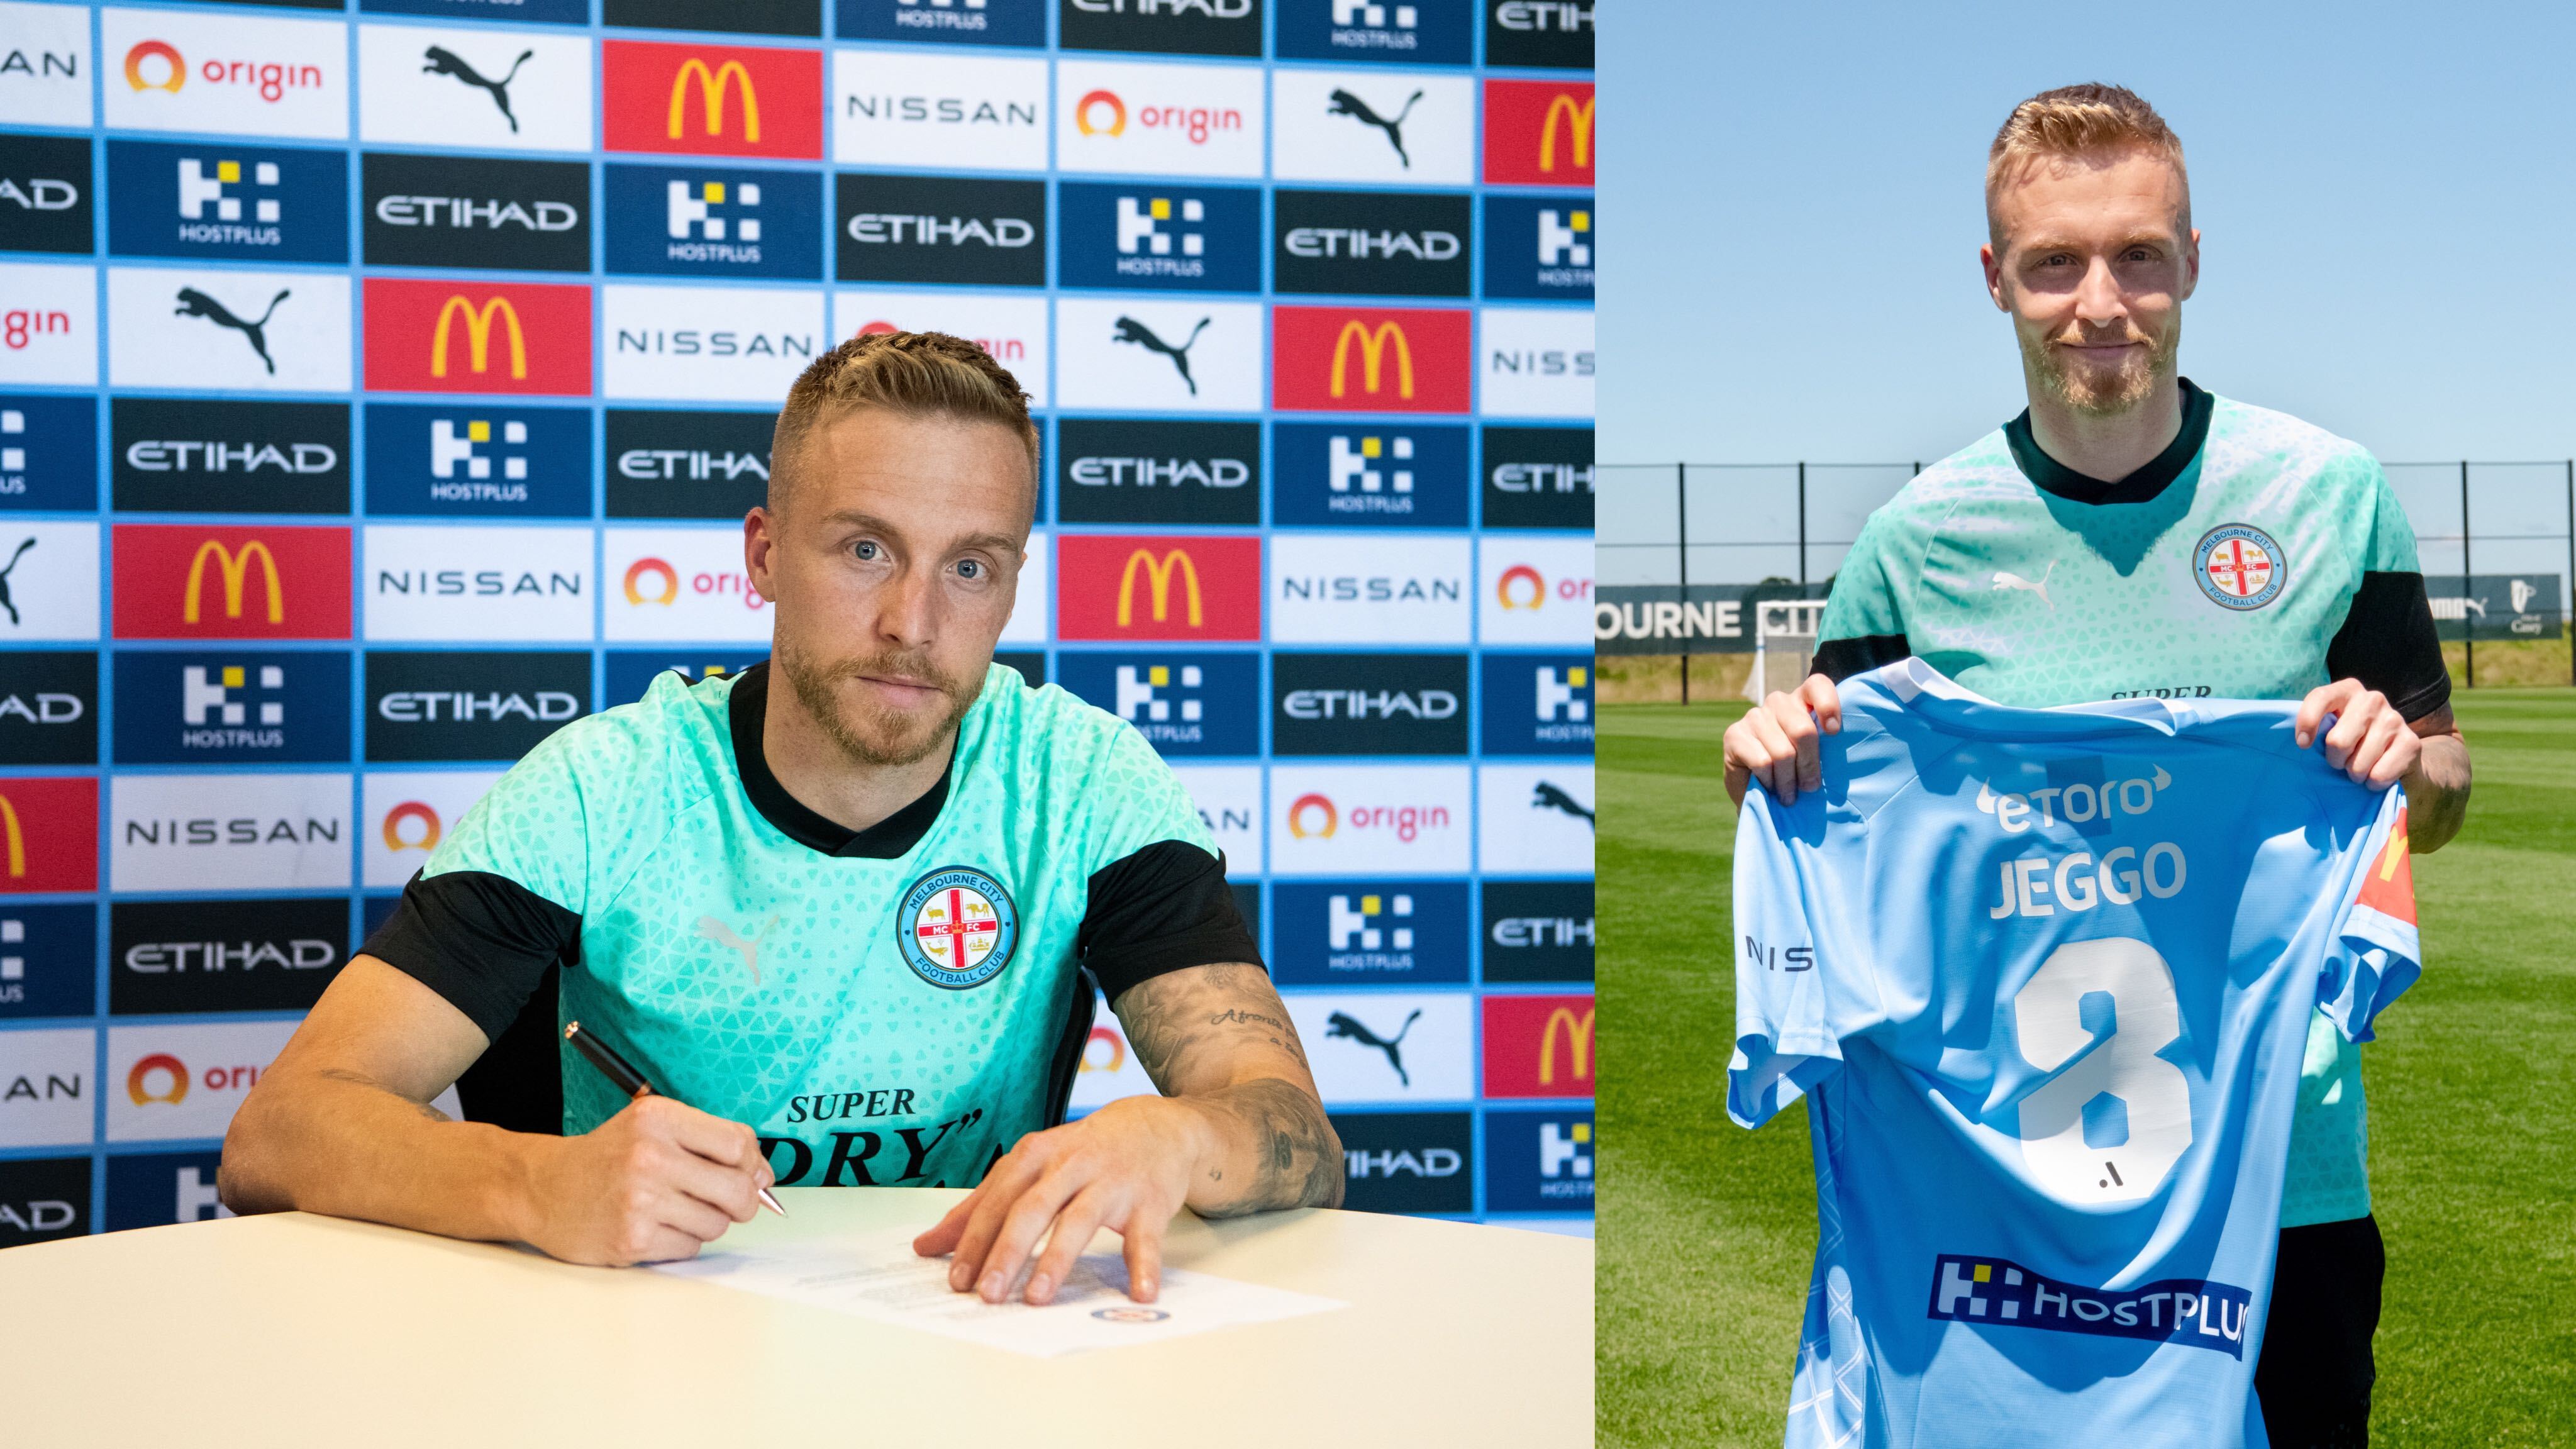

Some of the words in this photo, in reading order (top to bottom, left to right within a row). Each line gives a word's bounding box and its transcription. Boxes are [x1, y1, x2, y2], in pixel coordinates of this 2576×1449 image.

[896, 10, 987, 30] HOSTPLUS
[1496, 1, 1595, 31] ETIH
[202, 60, 321, 103] origin
[848, 95, 1035, 126] NISSAN
[1140, 106, 1241, 145] origin
[377, 196, 577, 230] ETIHAD
[179, 225, 280, 245] HOSTPLUS
[848, 214, 1034, 247] ETIHAD
[1285, 228, 1460, 259] ETIHAD
[668, 245, 762, 263] HOSTPLUS
[1117, 258, 1204, 276] HOSTPLUS
[4, 311, 69, 350] gin
[618, 330, 811, 357] NISSAN
[1493, 351, 1595, 375] NISS
[127, 441, 336, 472] ETIHAD
[619, 450, 769, 480] ETIHA
[1070, 457, 1248, 487] ETIHAD
[1492, 464, 1595, 492] ETIH
[431, 484, 527, 501] HOSTPLUS
[1329, 496, 1413, 513] HOSTPLUS
[2202, 529, 2253, 553] MELBOURNE
[2255, 534, 2274, 550] CITY
[379, 570, 580, 596] NISSAN
[693, 572, 767, 609] orig
[1284, 578, 1459, 601] NISSAN
[2209, 587, 2257, 606] FOOTBALL
[2258, 584, 2277, 602] CLUB
[1595, 600, 1743, 641] OURNE
[1763, 603, 1819, 637] CIT
[379, 692, 579, 721] ETIHAD
[1284, 691, 1457, 718] ETIHAD
[183, 730, 284, 747] HOSTPLUS
[1136, 724, 1202, 742] STPLUS
[127, 819, 338, 845] NISSAN
[1350, 807, 1449, 843] origin
[909, 874, 978, 909] MELBOURNE
[980, 882, 1004, 903] CITY
[1990, 841, 2187, 919] JEGGO
[933, 926, 949, 935] MC
[966, 923, 980, 931] FC
[1492, 918, 1595, 946] ETIH
[126, 940, 335, 973] ETIHAD
[916, 957, 977, 984] FOOTBALL
[979, 950, 1005, 976] CLUB
[1329, 954, 1413, 969] HOSTPLUS
[1745, 935, 1813, 972] NIS
[204, 1067, 257, 1092] ori
[2014, 936, 2192, 1204] 8
[787, 1089, 916, 1123] SUPER
[1344, 1149, 1462, 1178] IHAD
